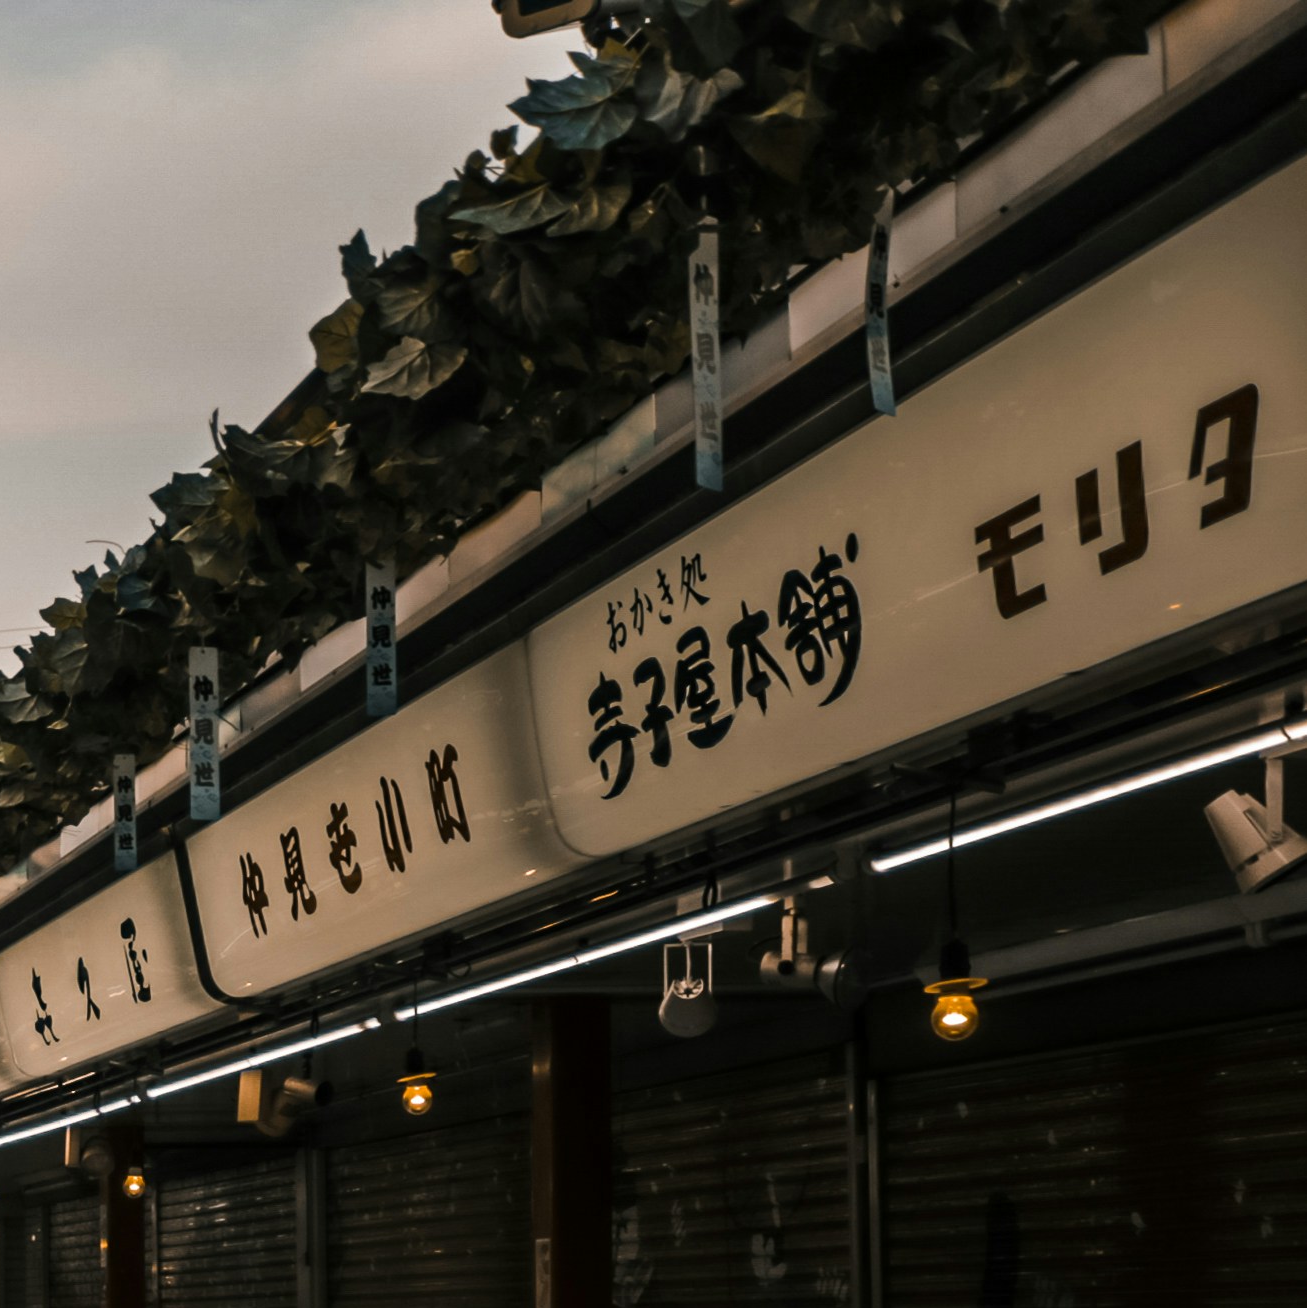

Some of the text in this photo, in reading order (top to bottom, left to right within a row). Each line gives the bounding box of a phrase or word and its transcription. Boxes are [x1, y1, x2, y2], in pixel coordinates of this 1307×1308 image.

[974, 382, 1260, 621] モリタ
[370, 585, 395, 688] 仲見世
[606, 552, 711, 655] おかき処
[588, 532, 863, 800] 寺子屋本舗
[192, 673, 216, 790] 仲見世
[116, 773, 134, 852] 仲見世
